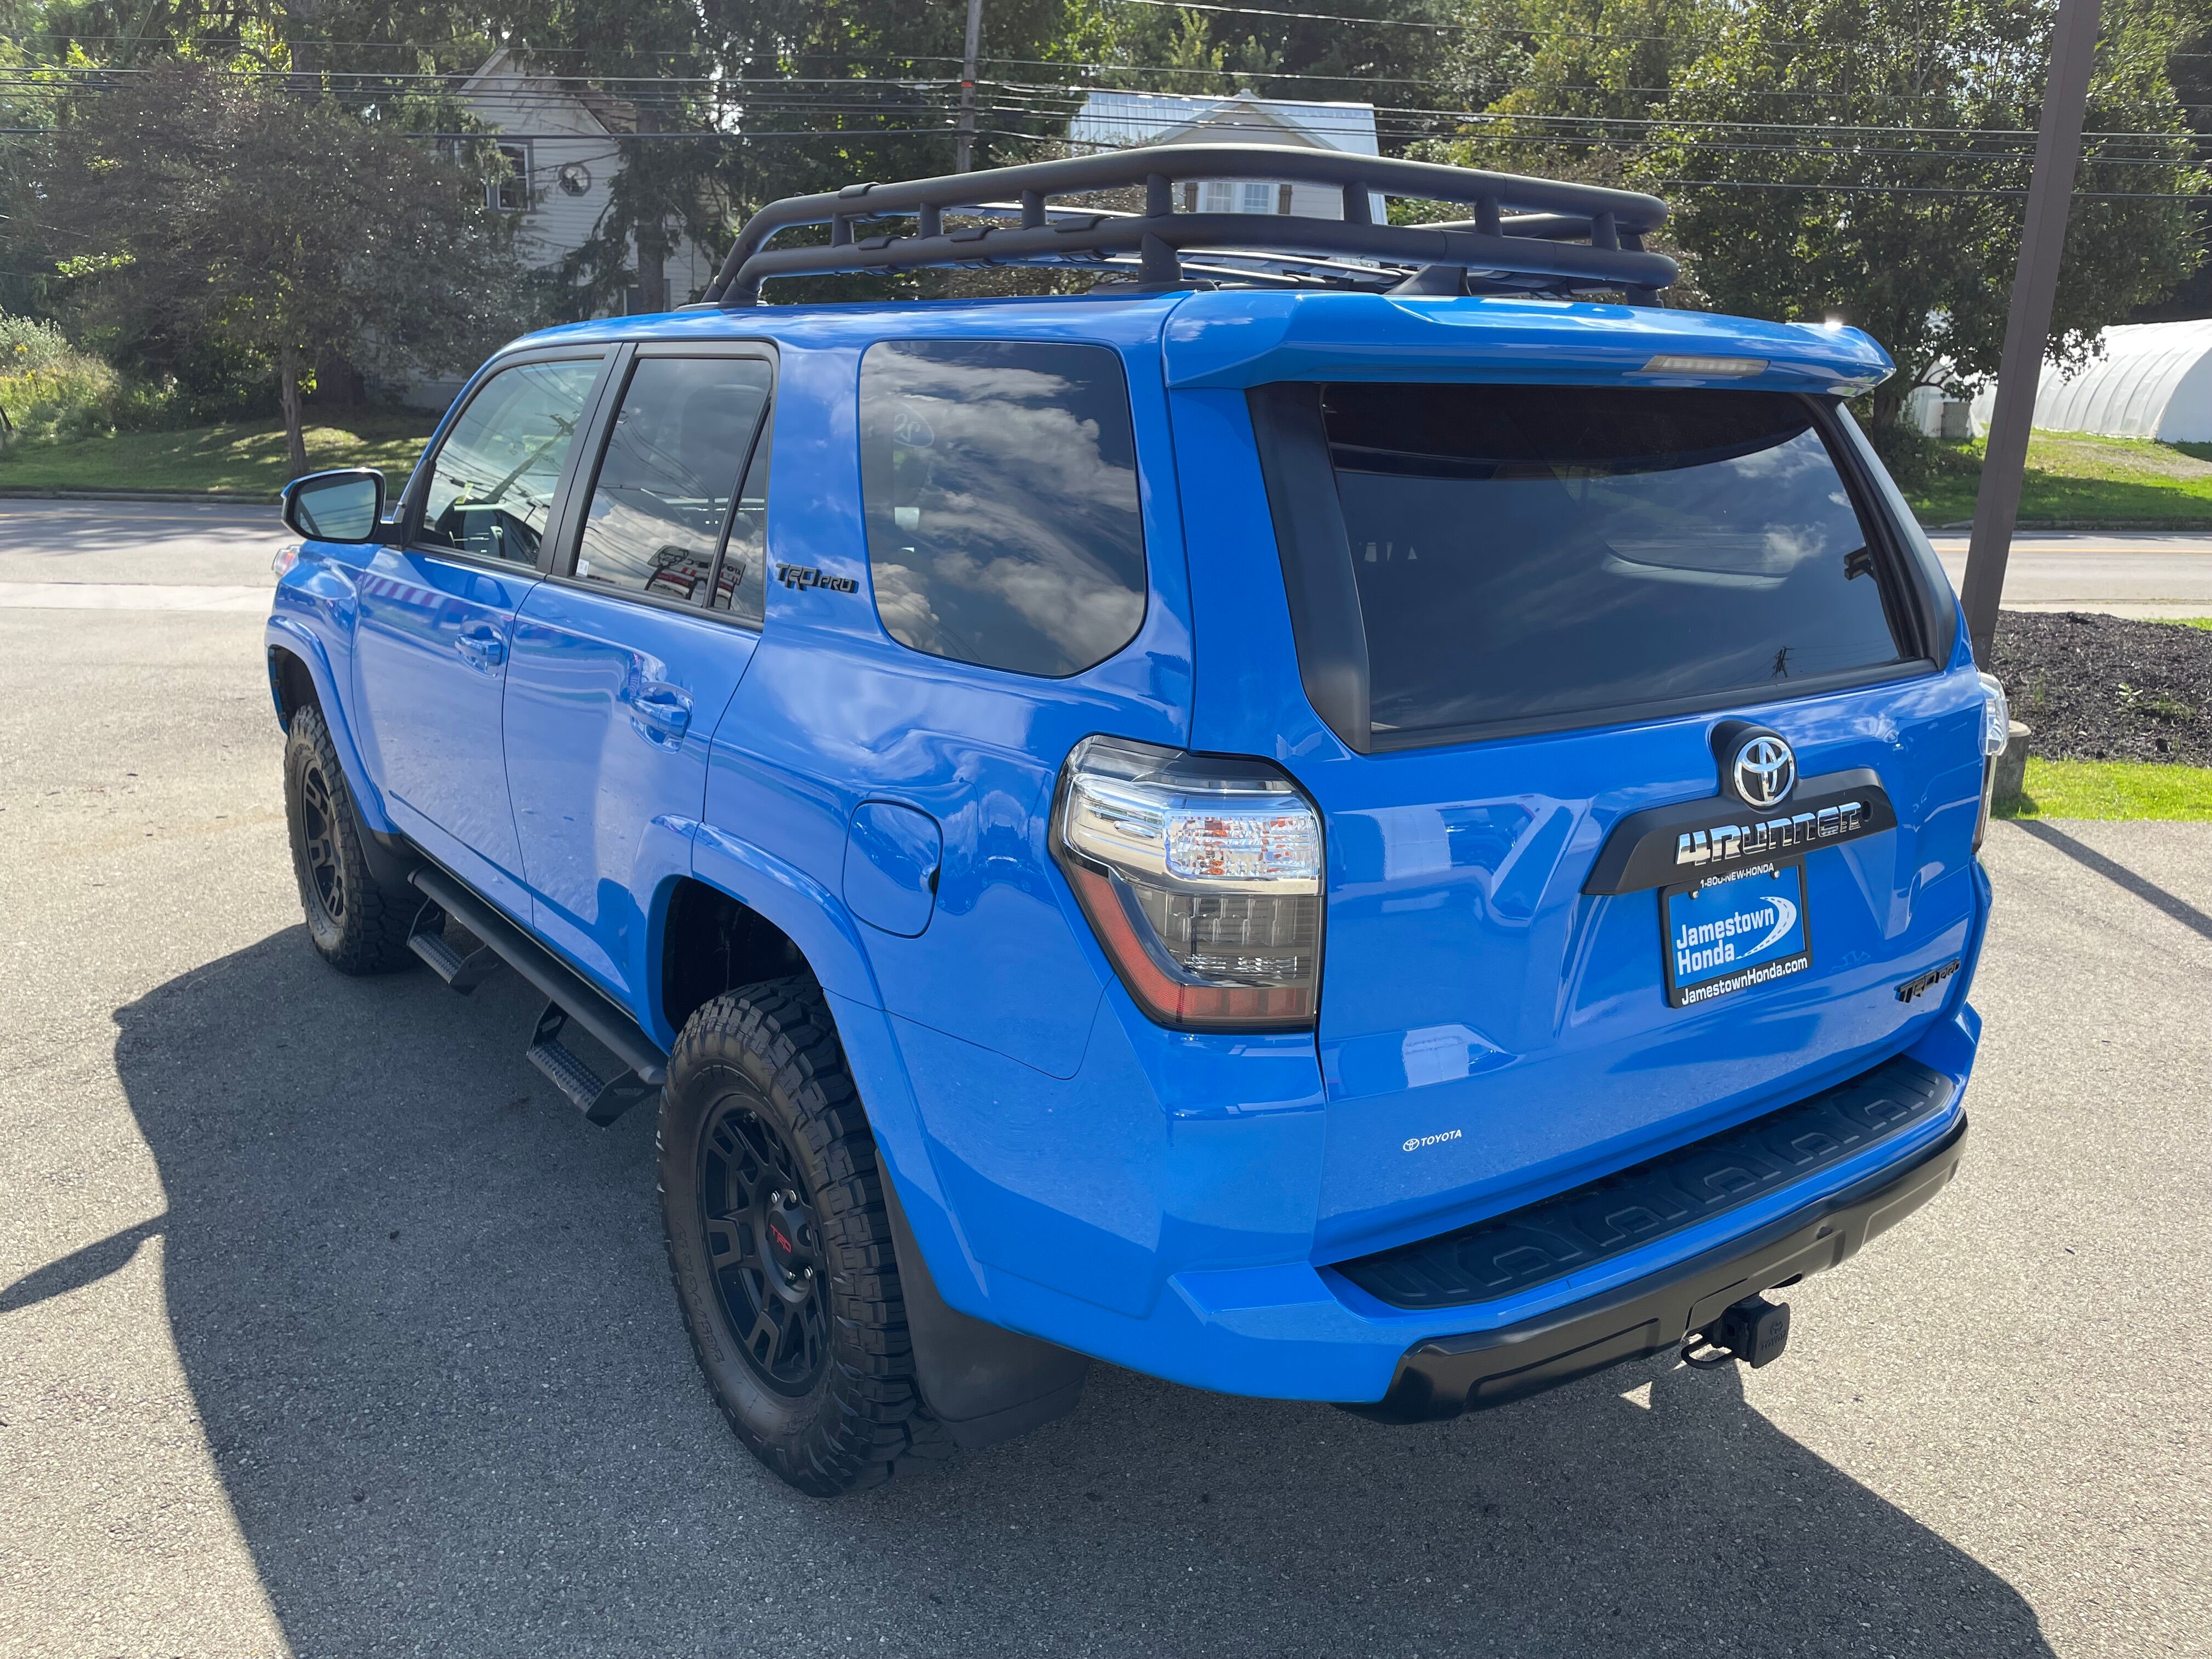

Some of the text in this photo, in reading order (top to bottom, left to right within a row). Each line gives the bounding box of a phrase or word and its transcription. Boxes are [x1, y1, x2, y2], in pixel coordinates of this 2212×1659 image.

[776, 563, 855, 593] TRD PRO
[1676, 907, 1775, 950] Jamestown
[1677, 939, 1735, 975] Honda
[1681, 957, 1808, 1006] JamestownHonda.com
[1895, 970, 1939, 1003] TRD
[1420, 1129, 1462, 1147] TOYOTA
[770, 1224, 791, 1253] TRD
